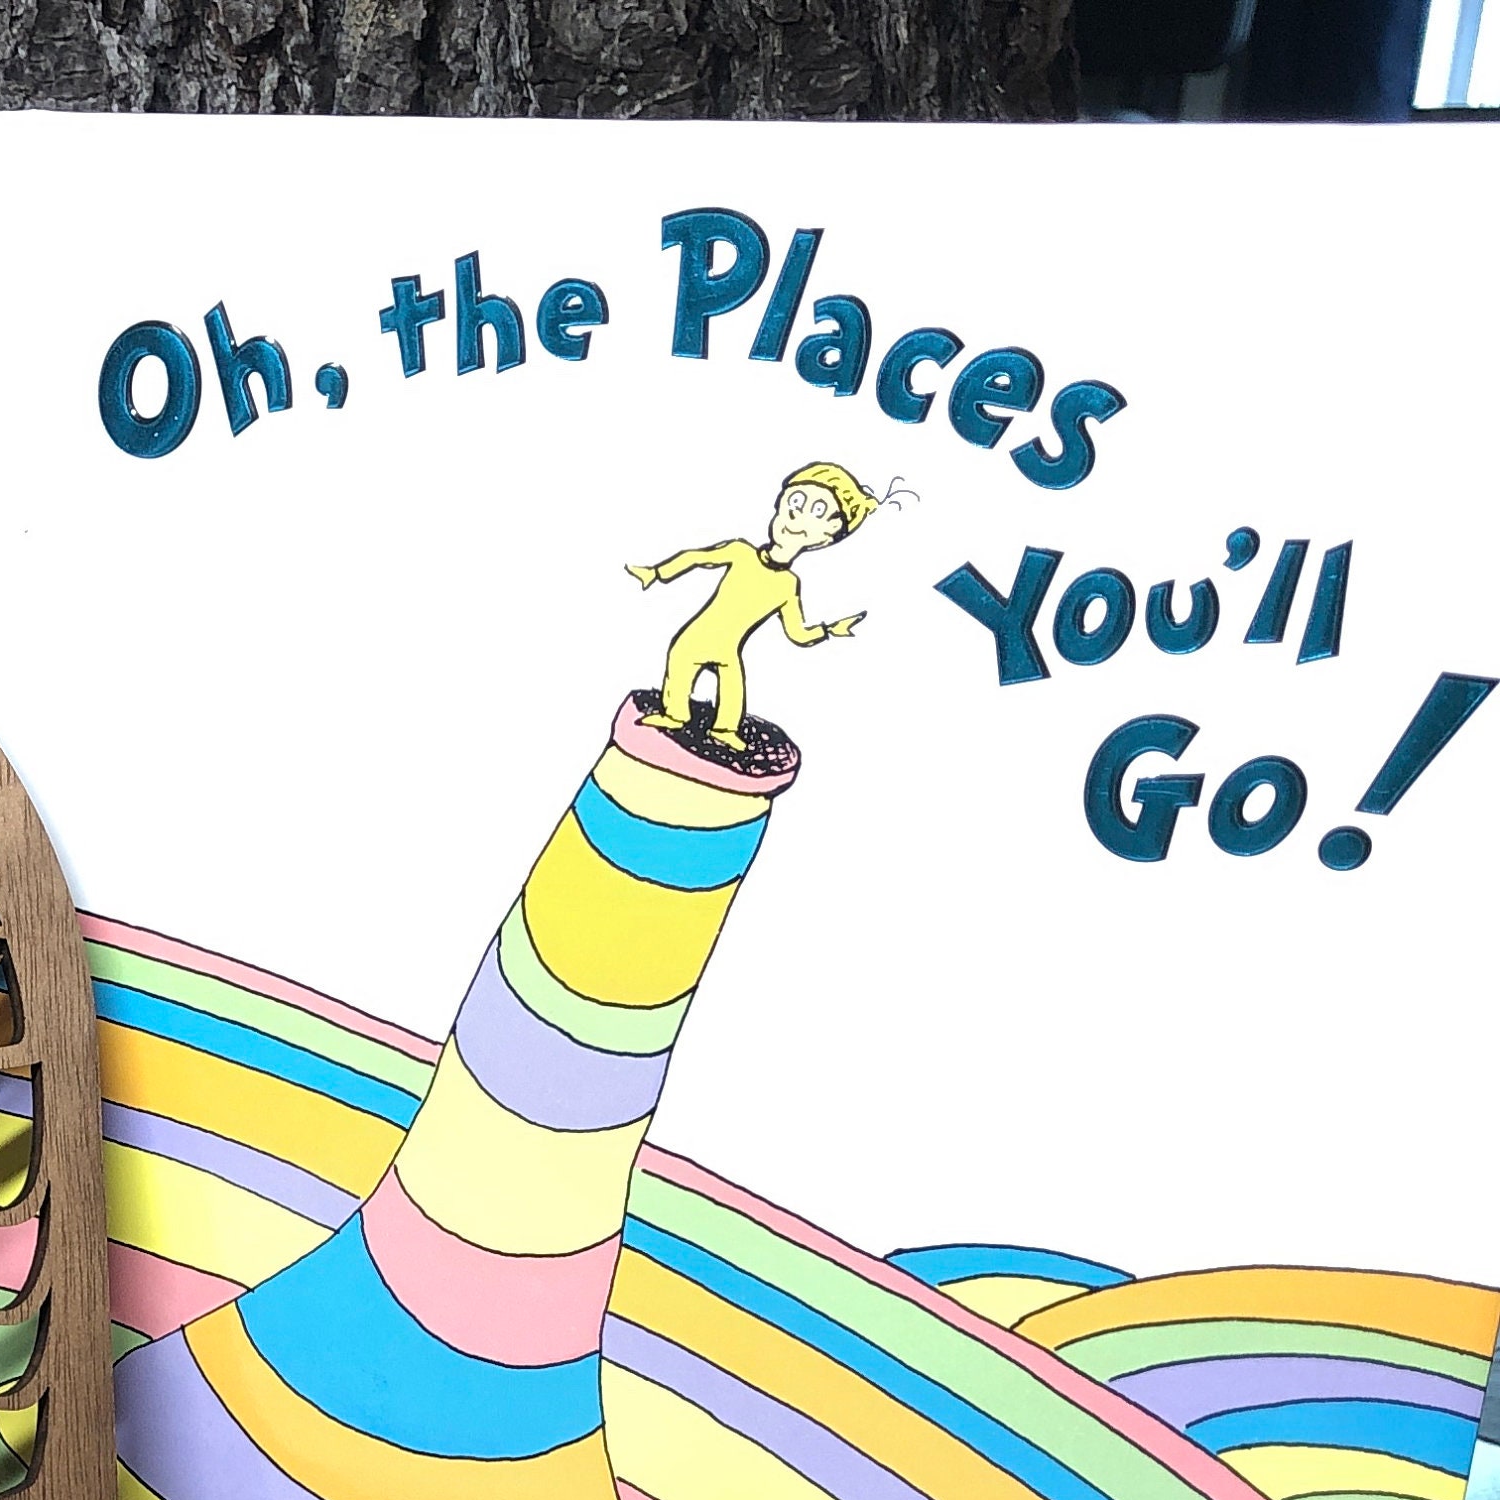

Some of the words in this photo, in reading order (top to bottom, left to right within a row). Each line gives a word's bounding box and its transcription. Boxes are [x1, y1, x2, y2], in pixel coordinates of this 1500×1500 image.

[98, 300, 349, 459] Oh,
[378, 250, 610, 379] the
[660, 207, 1129, 491] Places
[933, 526, 1353, 687] You'll
[1083, 672, 1500, 872] Go!
